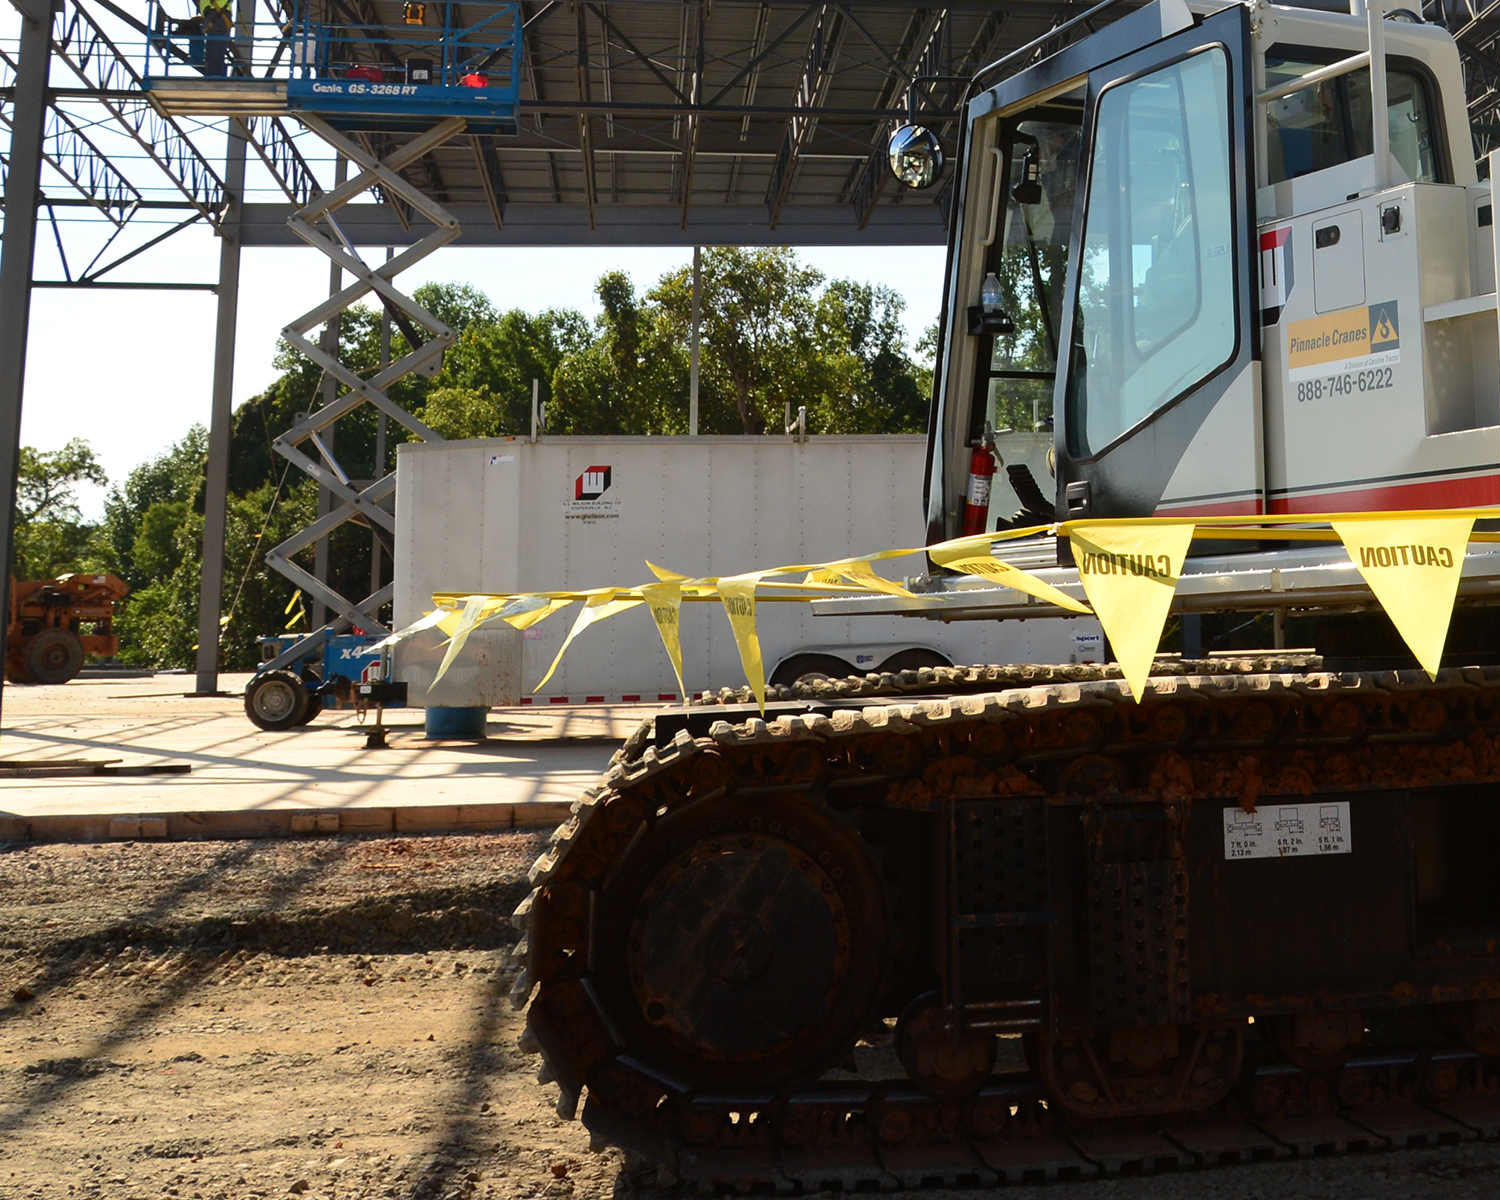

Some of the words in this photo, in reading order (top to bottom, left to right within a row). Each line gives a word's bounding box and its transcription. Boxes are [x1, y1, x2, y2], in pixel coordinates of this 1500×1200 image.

[312, 83, 343, 93] Genie
[348, 84, 400, 95] GS-3268
[401, 86, 418, 95] RT
[1289, 332, 1331, 354] Pinnacle
[1332, 327, 1367, 346] Cranes
[1297, 367, 1393, 403] 888-746-6222
